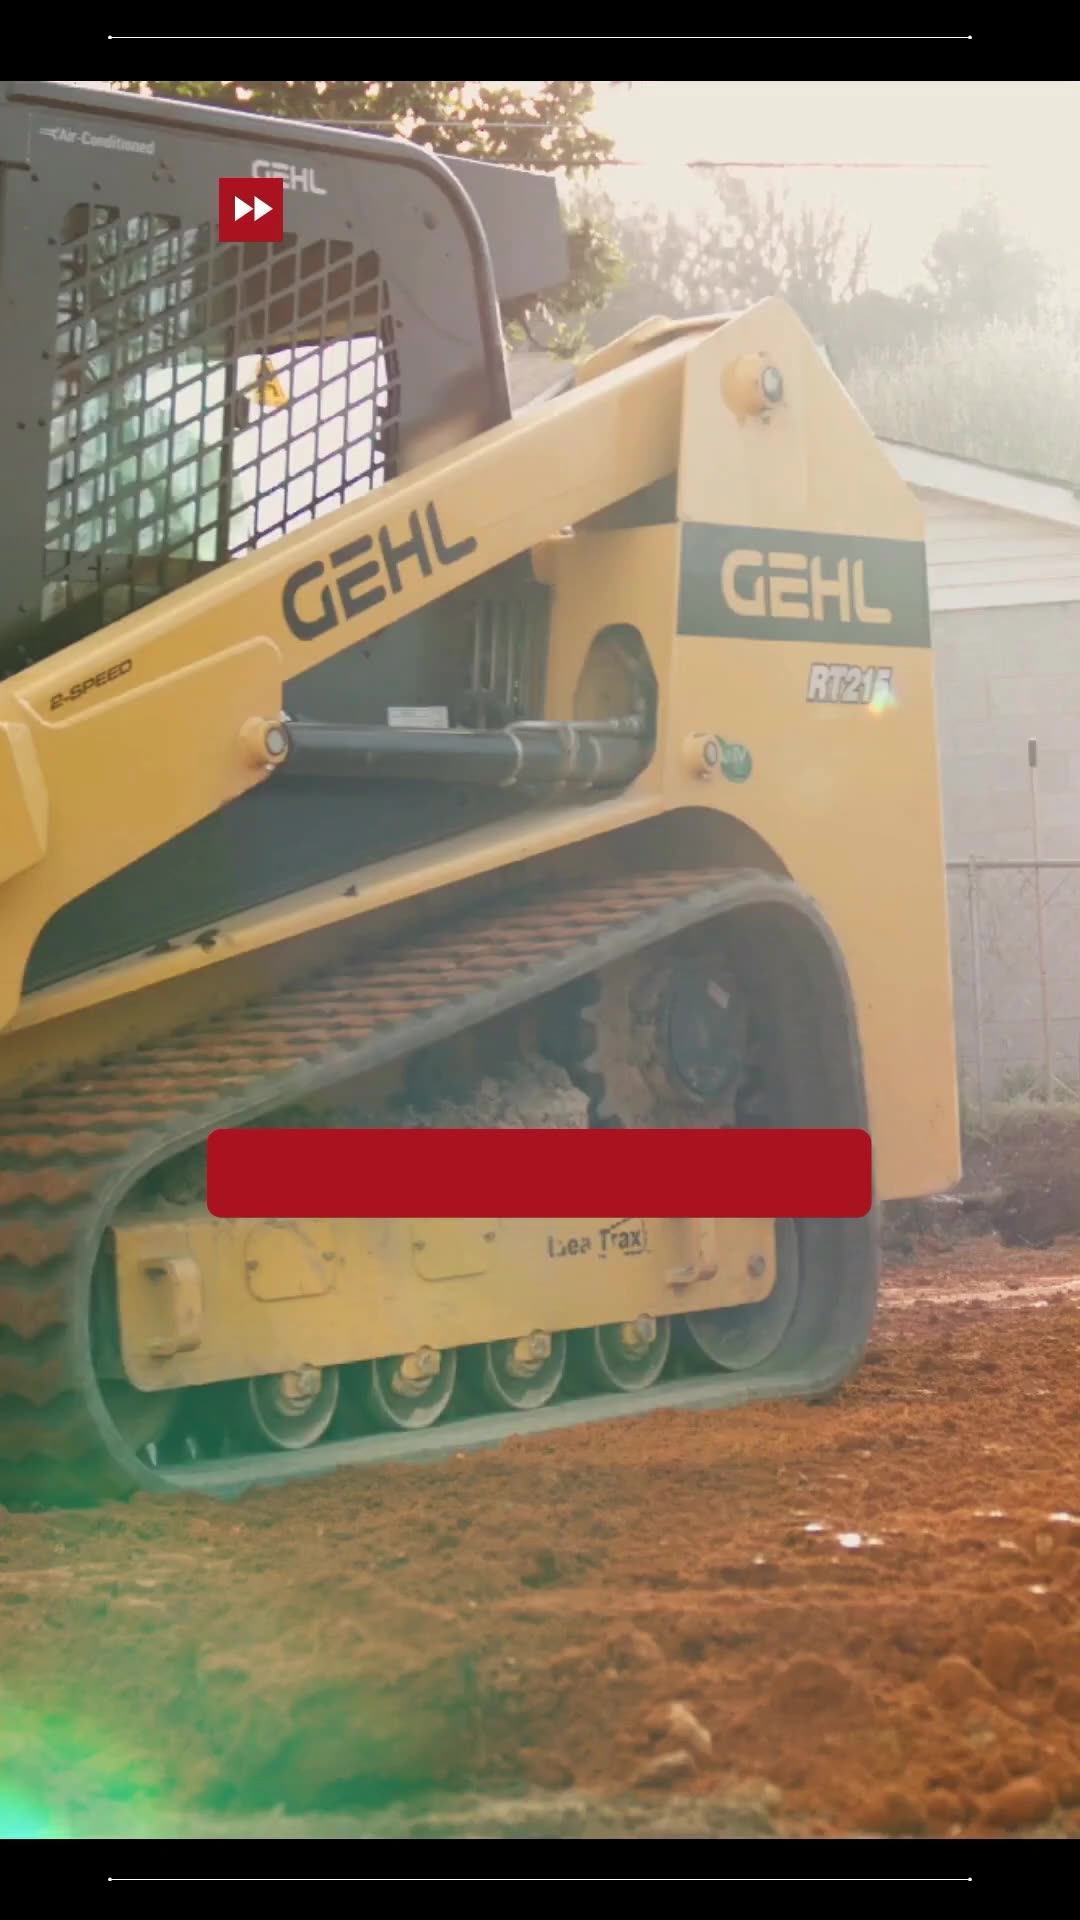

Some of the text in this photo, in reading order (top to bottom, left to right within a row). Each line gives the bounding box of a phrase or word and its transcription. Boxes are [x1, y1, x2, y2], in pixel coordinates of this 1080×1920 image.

[57, 127, 155, 155] Air-Conditioned
[282, 501, 478, 641] GEHL
[720, 549, 892, 625] GEHL
[49, 658, 133, 712] 2-SPEED
